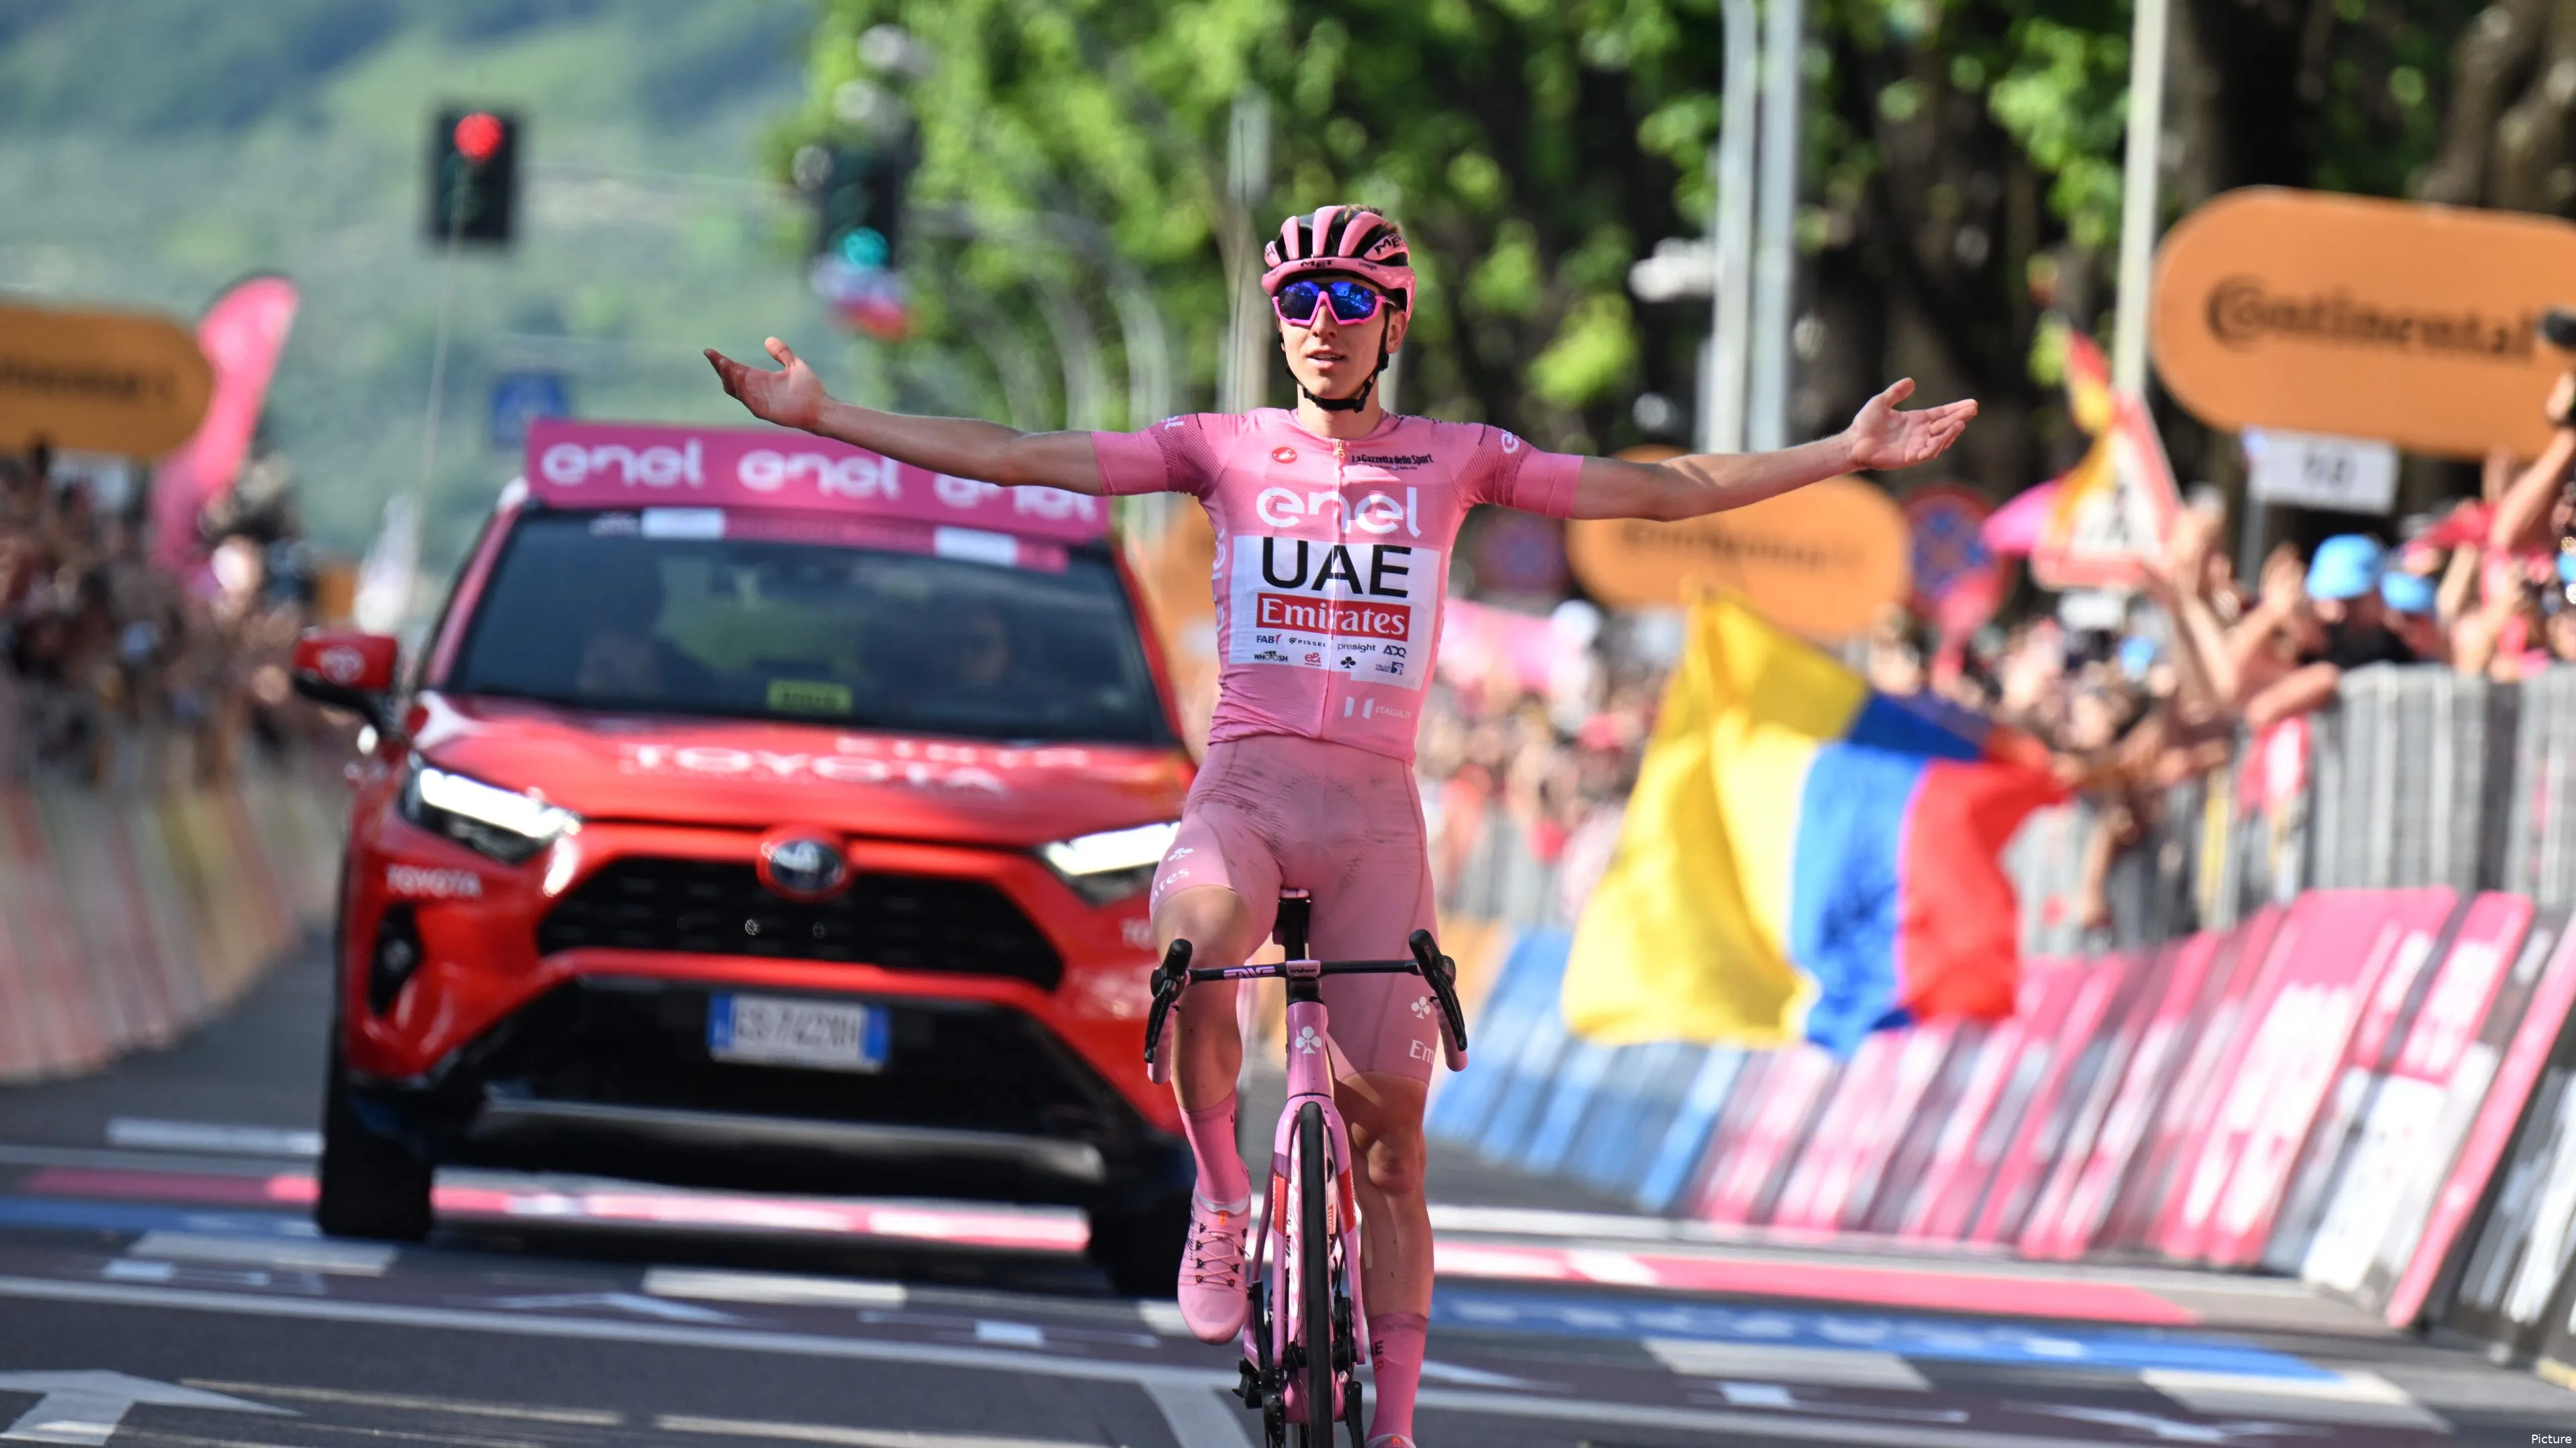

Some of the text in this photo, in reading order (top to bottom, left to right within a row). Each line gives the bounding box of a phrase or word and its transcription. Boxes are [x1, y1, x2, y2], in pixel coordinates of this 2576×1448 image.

[1300, 259, 1334, 268] MET
[1374, 235, 1403, 255] ME
[541, 437, 704, 489] enel
[738, 448, 903, 501] enel
[1362, 454, 1393, 464] Gazzetta
[1394, 456, 1411, 464] dello
[1411, 454, 1434, 465] Sport
[1256, 486, 1421, 537] enel
[1263, 536, 1412, 598] UAE
[1262, 598, 1405, 635] Emirates
[1256, 635, 1275, 643] FAB
[1338, 643, 1376, 652] presight
[1383, 645, 1406, 658] ADQ
